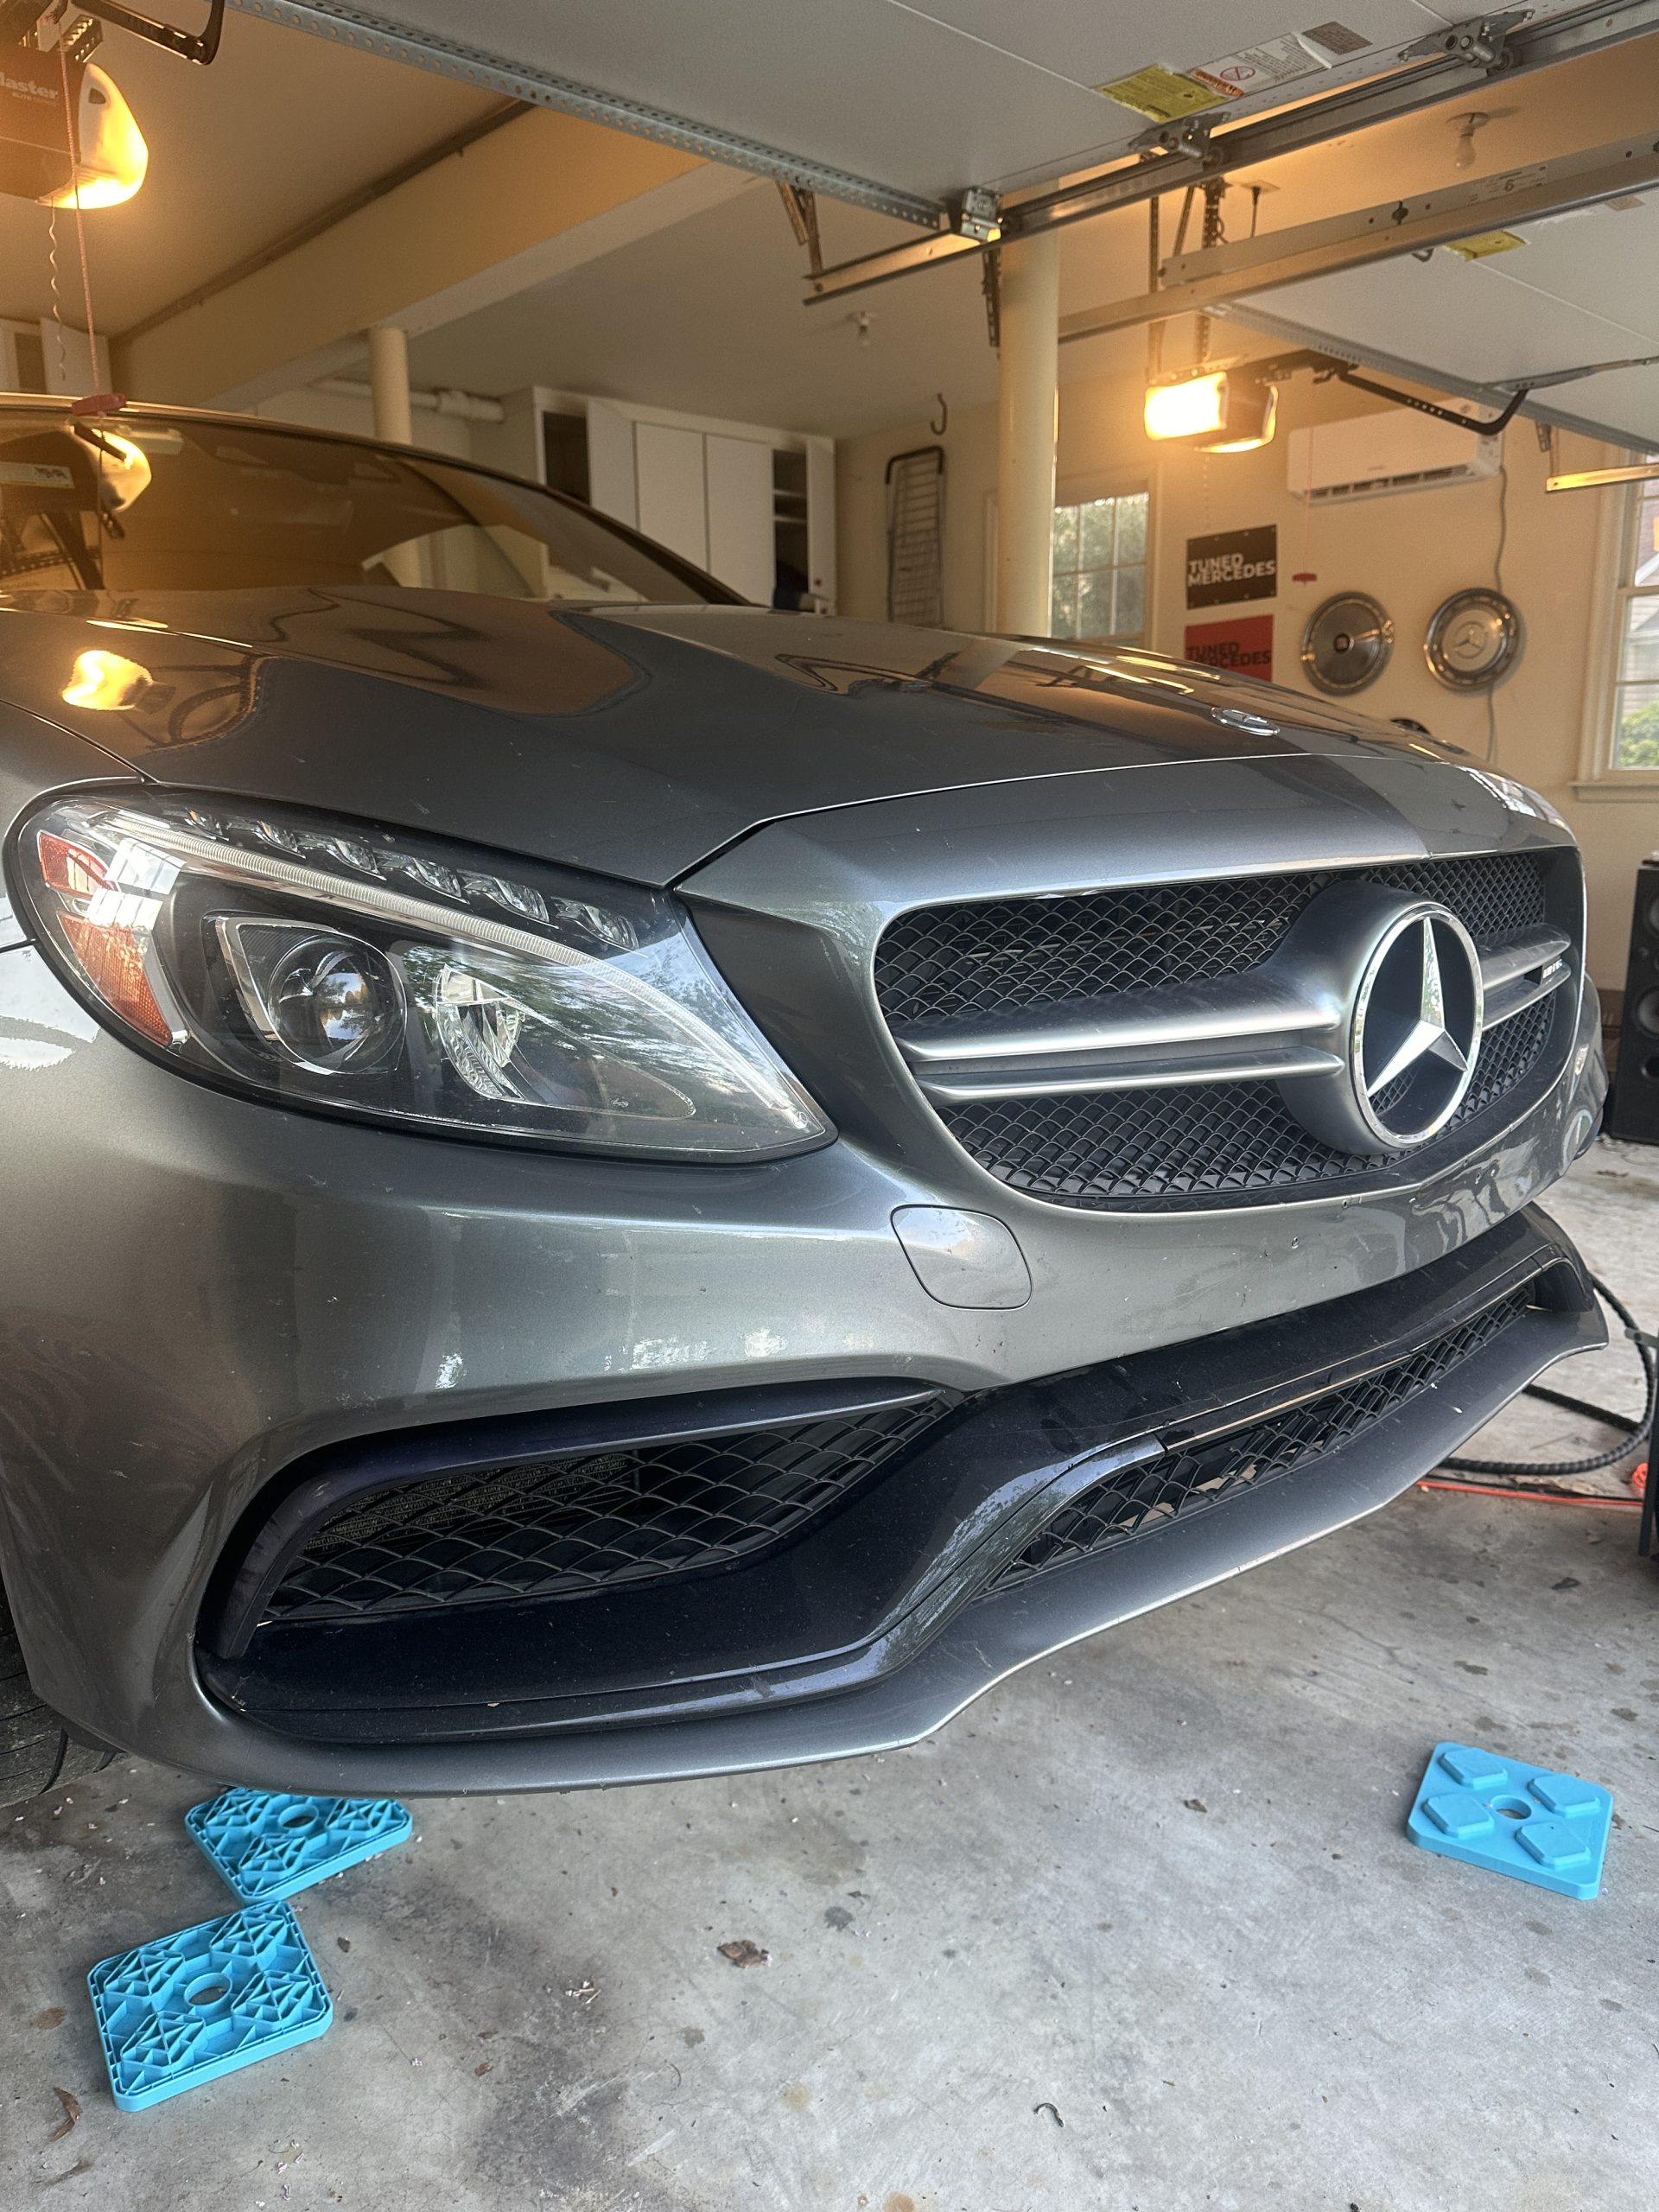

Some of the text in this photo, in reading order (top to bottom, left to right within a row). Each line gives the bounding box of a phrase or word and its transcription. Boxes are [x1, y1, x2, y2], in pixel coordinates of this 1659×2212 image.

[1187, 560, 1275, 587] MERCEDES
[1188, 553, 1243, 574] TUNED
[1186, 641, 1239, 662] TUNED
